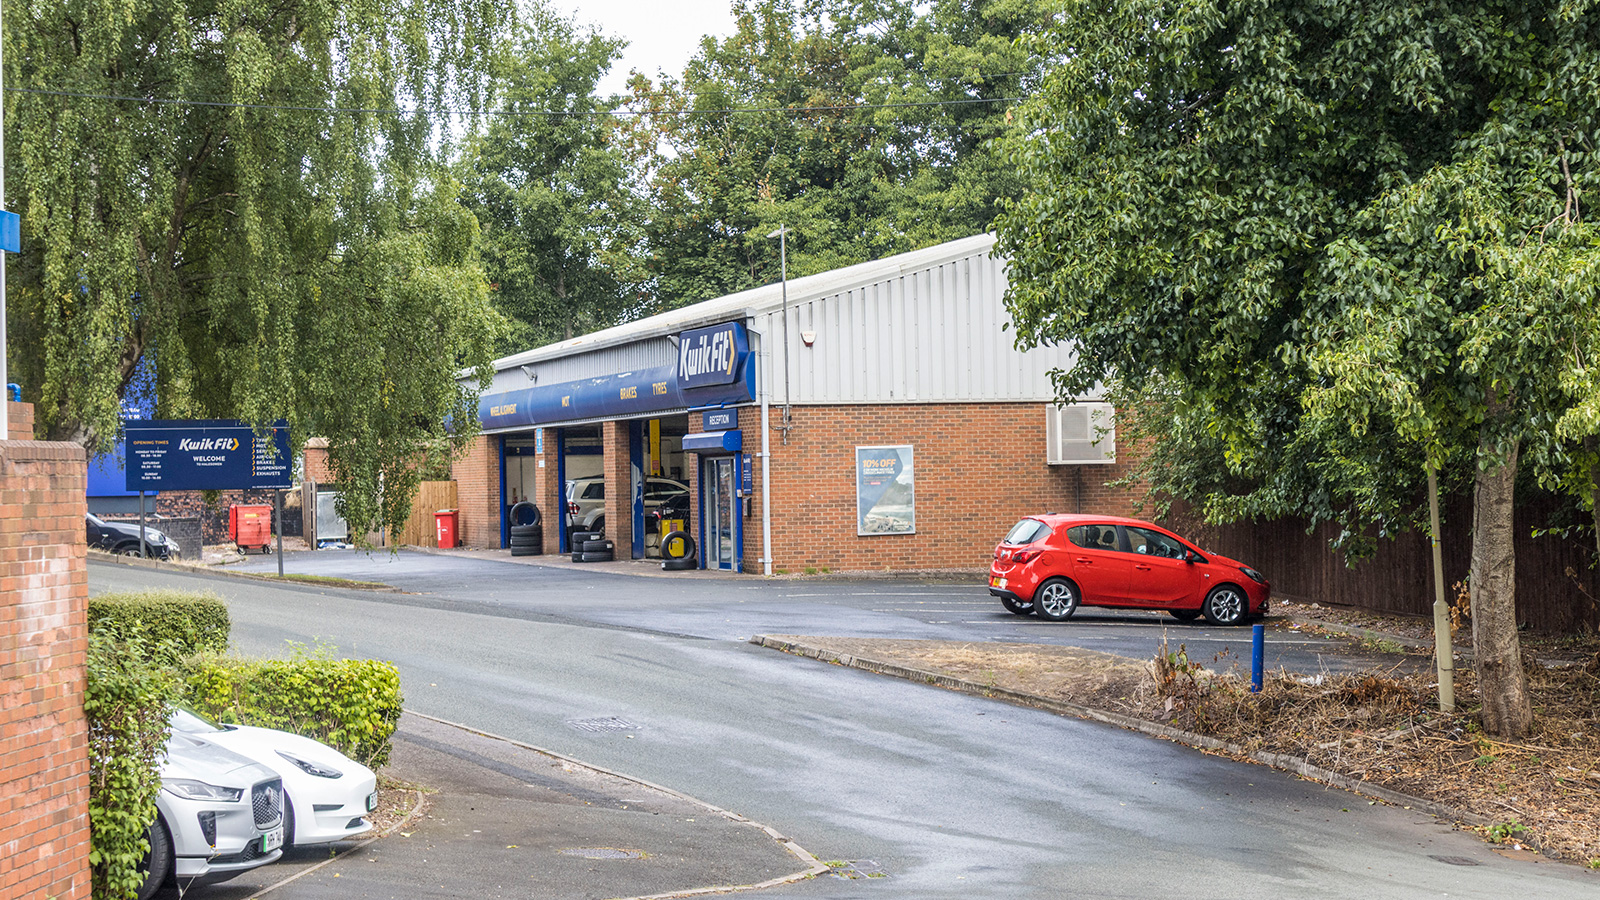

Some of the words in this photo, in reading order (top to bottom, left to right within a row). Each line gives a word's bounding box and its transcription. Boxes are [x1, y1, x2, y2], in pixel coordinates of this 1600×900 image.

[620, 386, 637, 399] BRAKES
[652, 382, 667, 395] TYRES
[561, 396, 570, 407] MOT
[709, 414, 730, 426] RECEPTION
[862, 459, 879, 468] 10%
[880, 459, 896, 468] OFF
